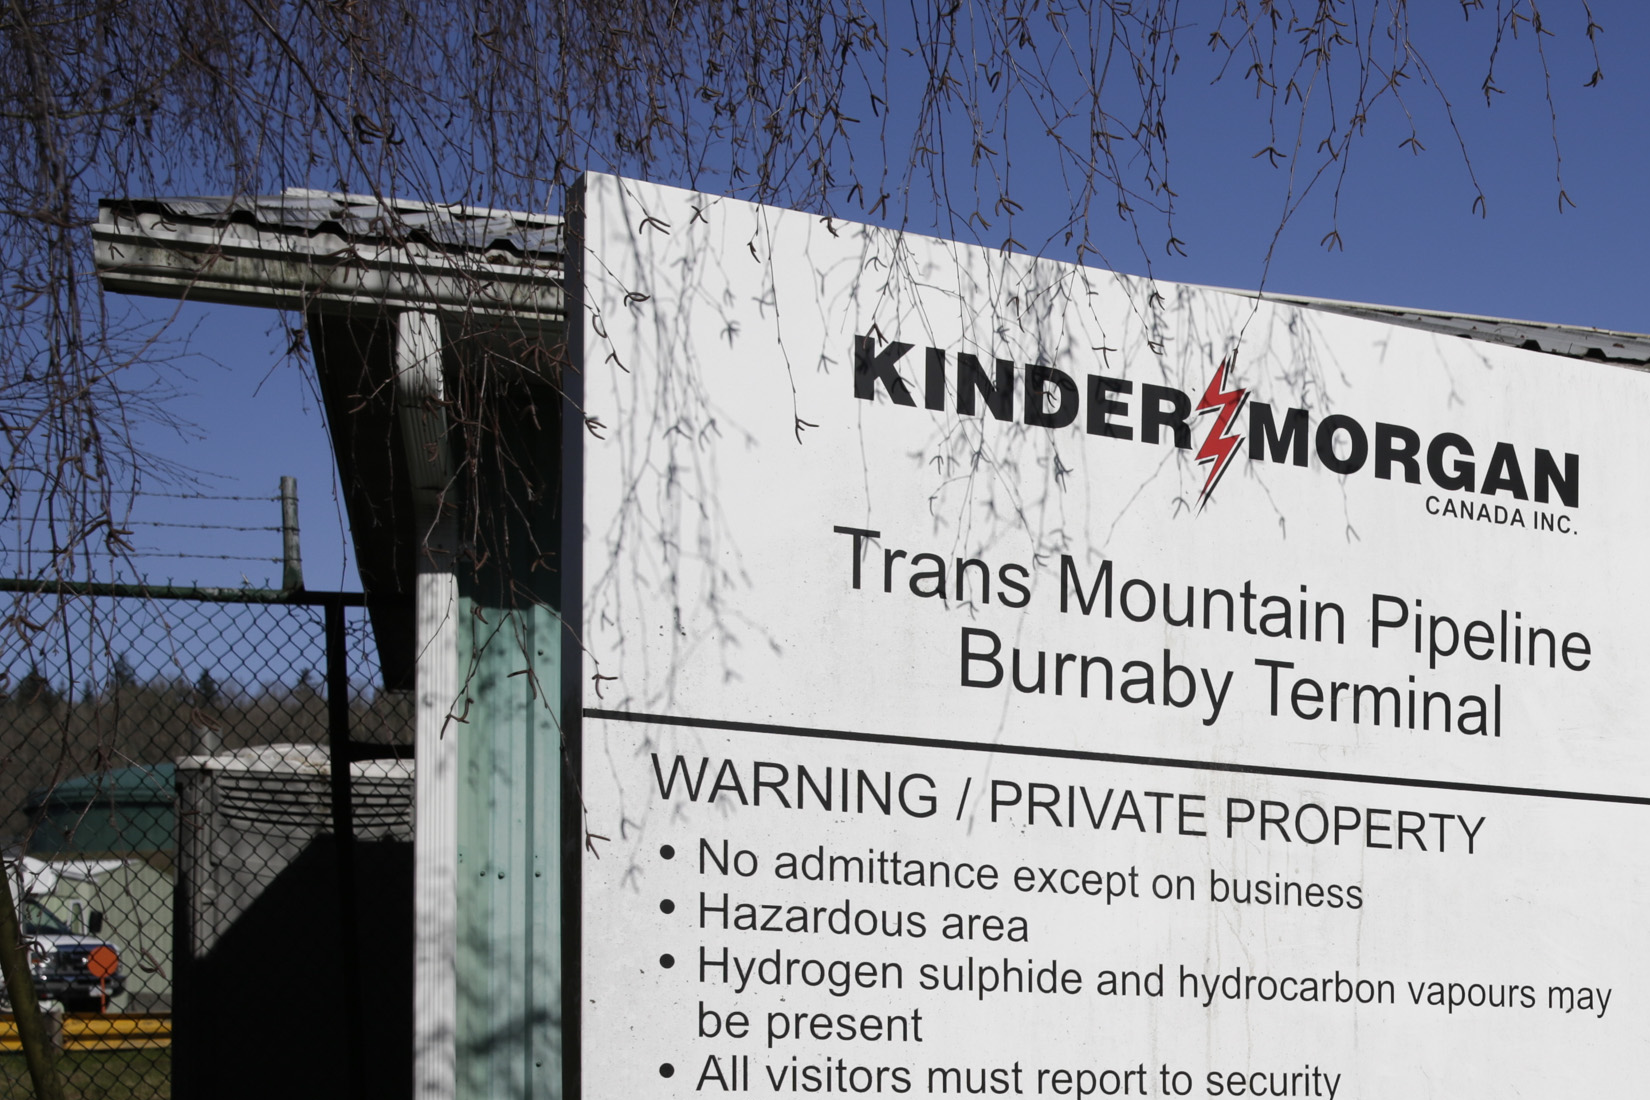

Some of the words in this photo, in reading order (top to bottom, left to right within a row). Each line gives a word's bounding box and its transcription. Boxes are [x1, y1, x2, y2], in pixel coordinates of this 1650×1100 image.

[854, 335, 1192, 451] KINDER
[1249, 404, 1579, 508] MORGAN
[1425, 495, 1526, 531] CANADA
[1531, 511, 1578, 536] INC.
[834, 526, 1030, 608] Trans
[1061, 555, 1343, 644] Mountain
[1373, 594, 1590, 671] Pipeline
[962, 627, 1233, 726] Burnaby
[1255, 659, 1500, 736] Terminal
[651, 753, 936, 817] WARNING
[957, 778, 971, 820] /
[992, 780, 1206, 836] PRIVATE
[1227, 798, 1485, 854] PROPERTY
[700, 838, 757, 876] No
[775, 846, 998, 889] admittance
[1015, 867, 1138, 904] except
[1153, 875, 1194, 900] on
[1211, 870, 1362, 909] business
[700, 892, 926, 937] Hazardous
[943, 914, 1027, 941] area
[700, 947, 901, 996] Hydrogen
[920, 957, 1081, 1000] sulphide
[1098, 964, 1162, 996] and
[1181, 965, 1394, 1007] hydrocarbon
[1408, 982, 1535, 1013] vapours
[1549, 987, 1611, 1018] may
[699, 1001, 749, 1038] be
[768, 1009, 922, 1048] present
[696, 1055, 747, 1091] All
[766, 1059, 911, 1093] visitors
[929, 1062, 1022, 1094] must
[1160, 1065, 1192, 1095] to
